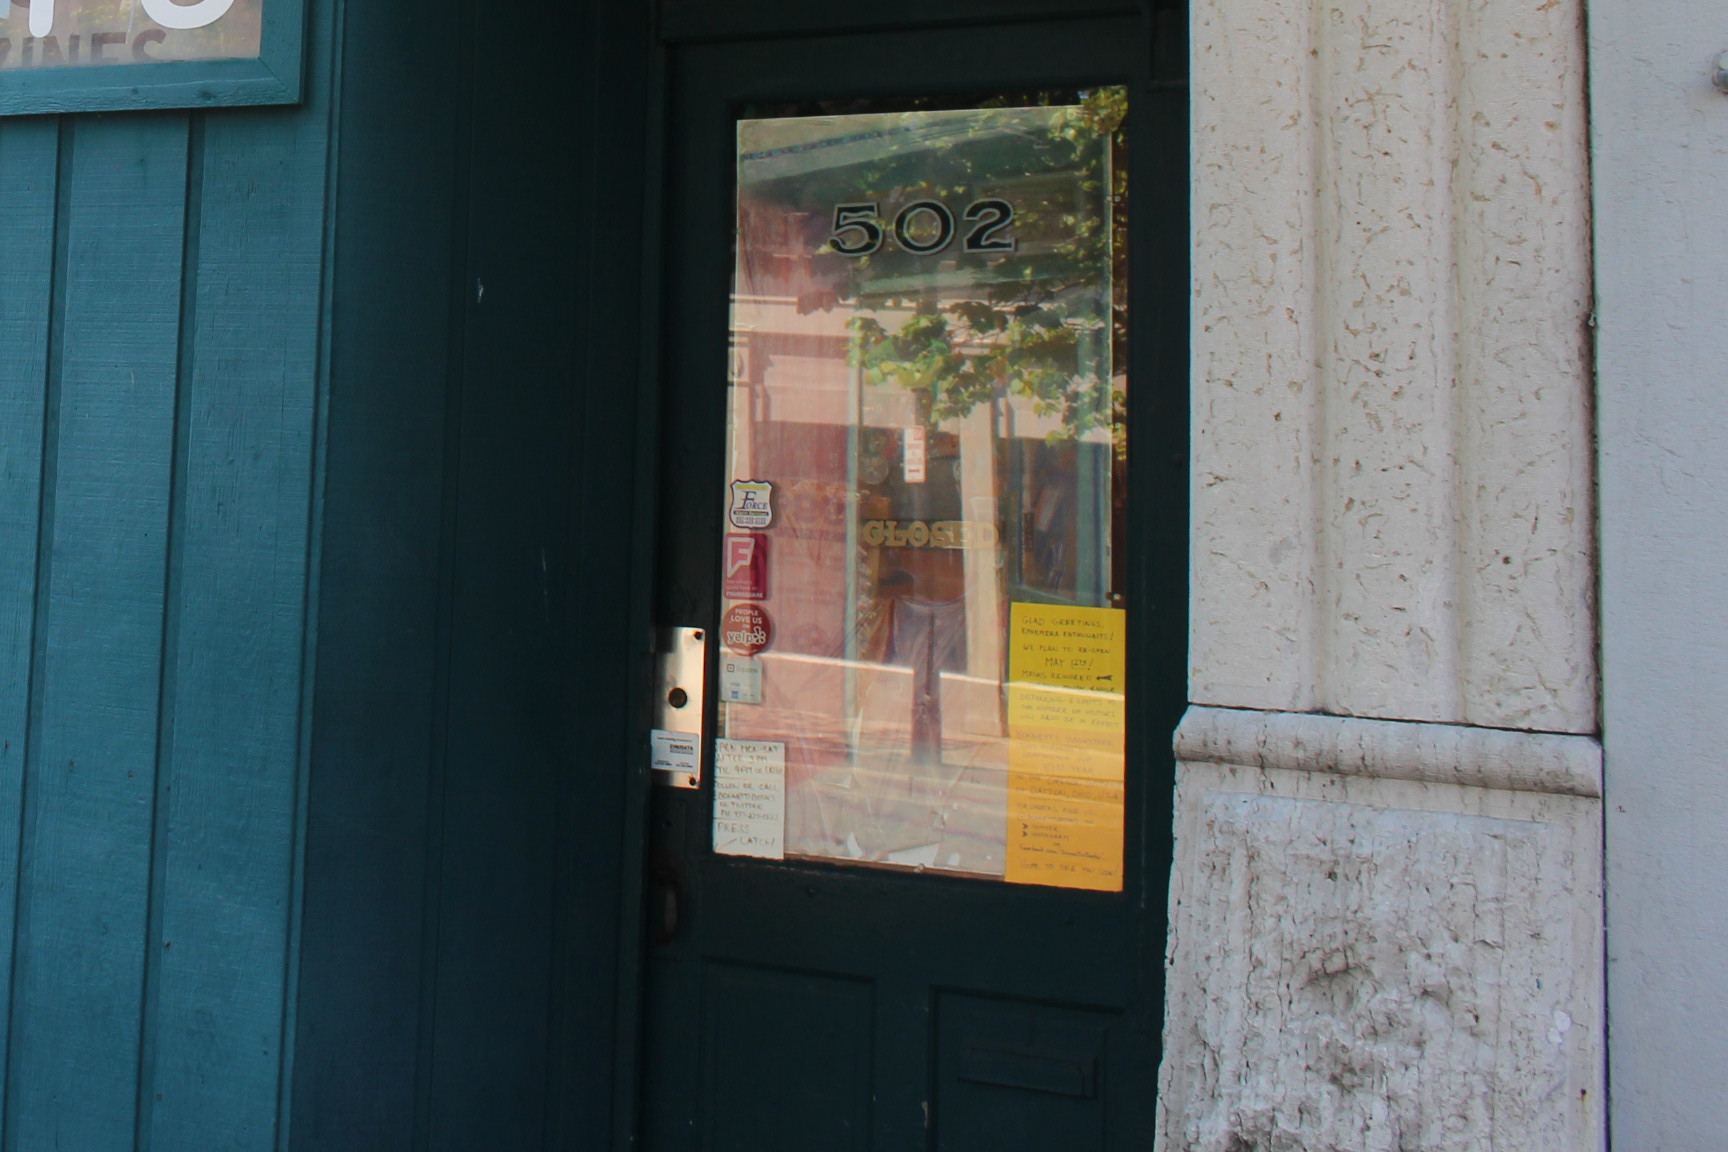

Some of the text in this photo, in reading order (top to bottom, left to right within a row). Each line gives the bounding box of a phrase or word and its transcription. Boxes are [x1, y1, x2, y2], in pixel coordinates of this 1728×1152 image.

[828, 199, 1020, 257] 502
[862, 520, 1000, 549] CLOSED
[730, 615, 751, 623] LOVE
[734, 608, 759, 616] PEOPLE
[727, 631, 755, 646] yelp
